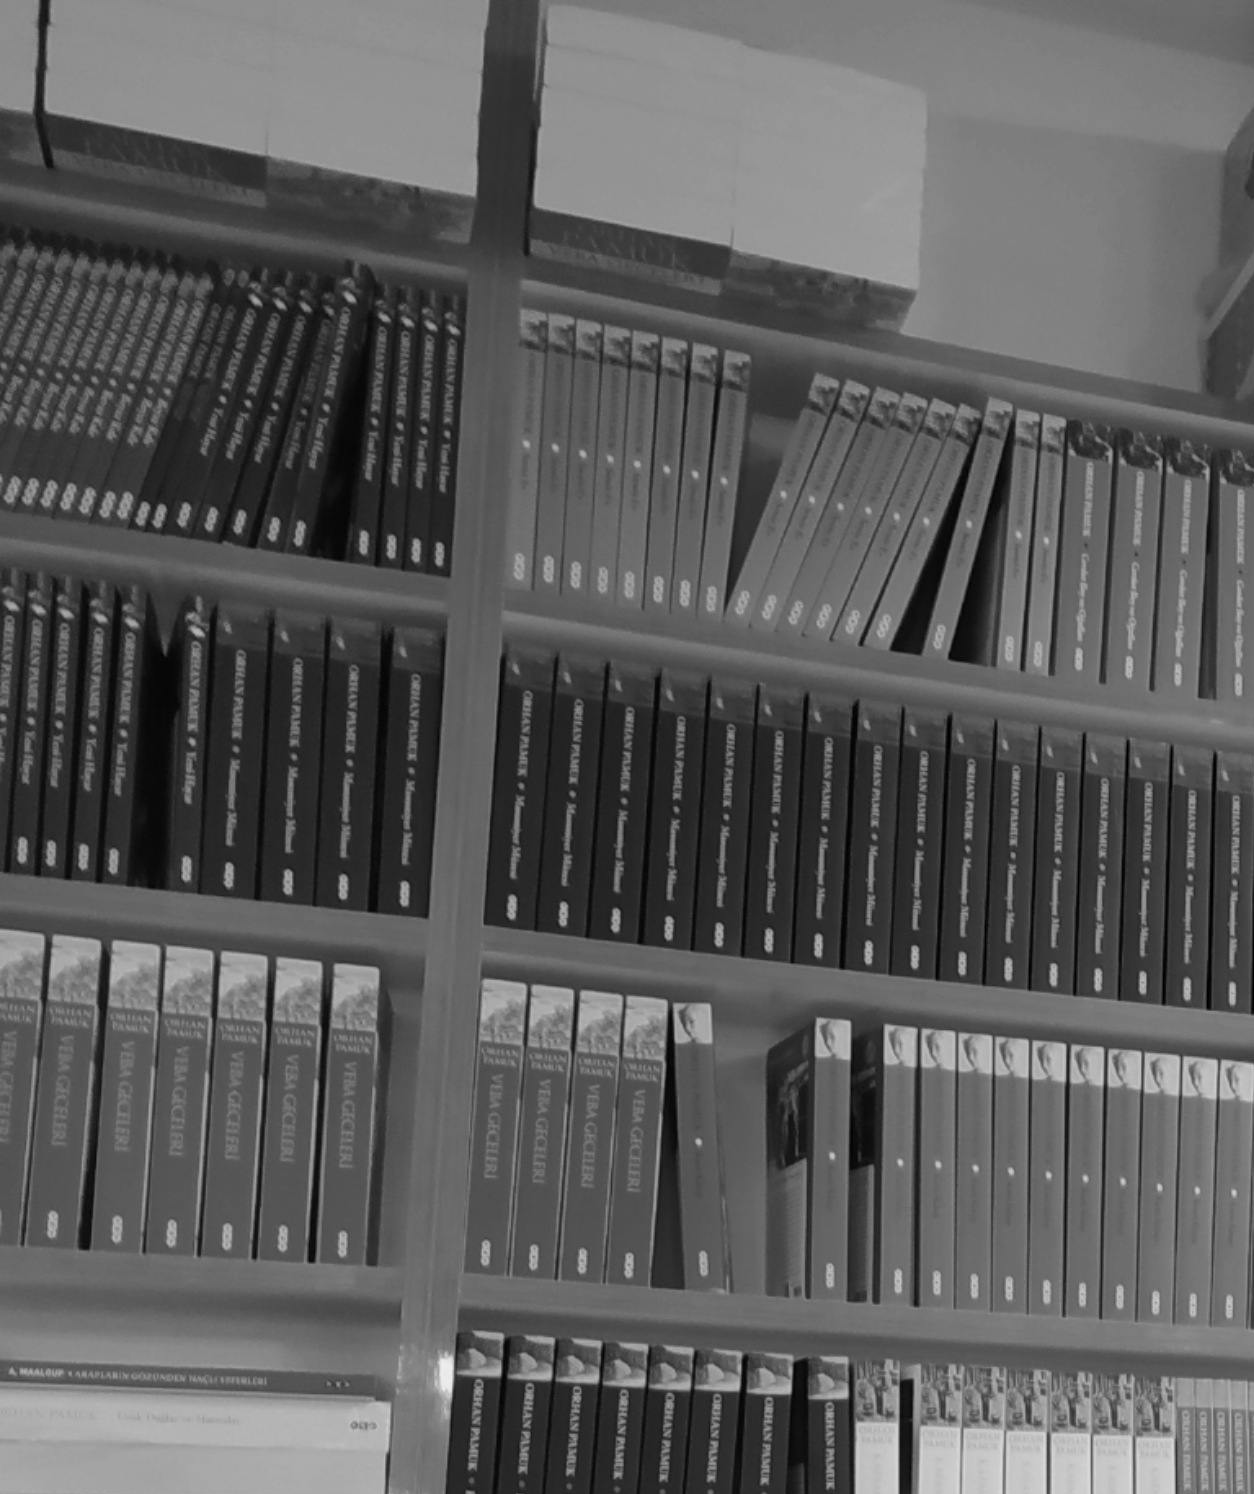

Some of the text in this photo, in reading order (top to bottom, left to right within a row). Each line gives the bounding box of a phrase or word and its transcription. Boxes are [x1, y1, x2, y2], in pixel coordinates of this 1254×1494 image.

[231, 695, 244, 739] PAMUK
[283, 1054, 299, 1090] VEBA
[342, 1061, 357, 1096] VEBA
[585, 1083, 600, 1119] VEBA
[631, 1089, 645, 1123] VEBA
[471, 1377, 484, 1425] ORHAN
[467, 1426, 480, 1470] PAMUK
[612, 1388, 629, 1479] ORHAN PAMUK
